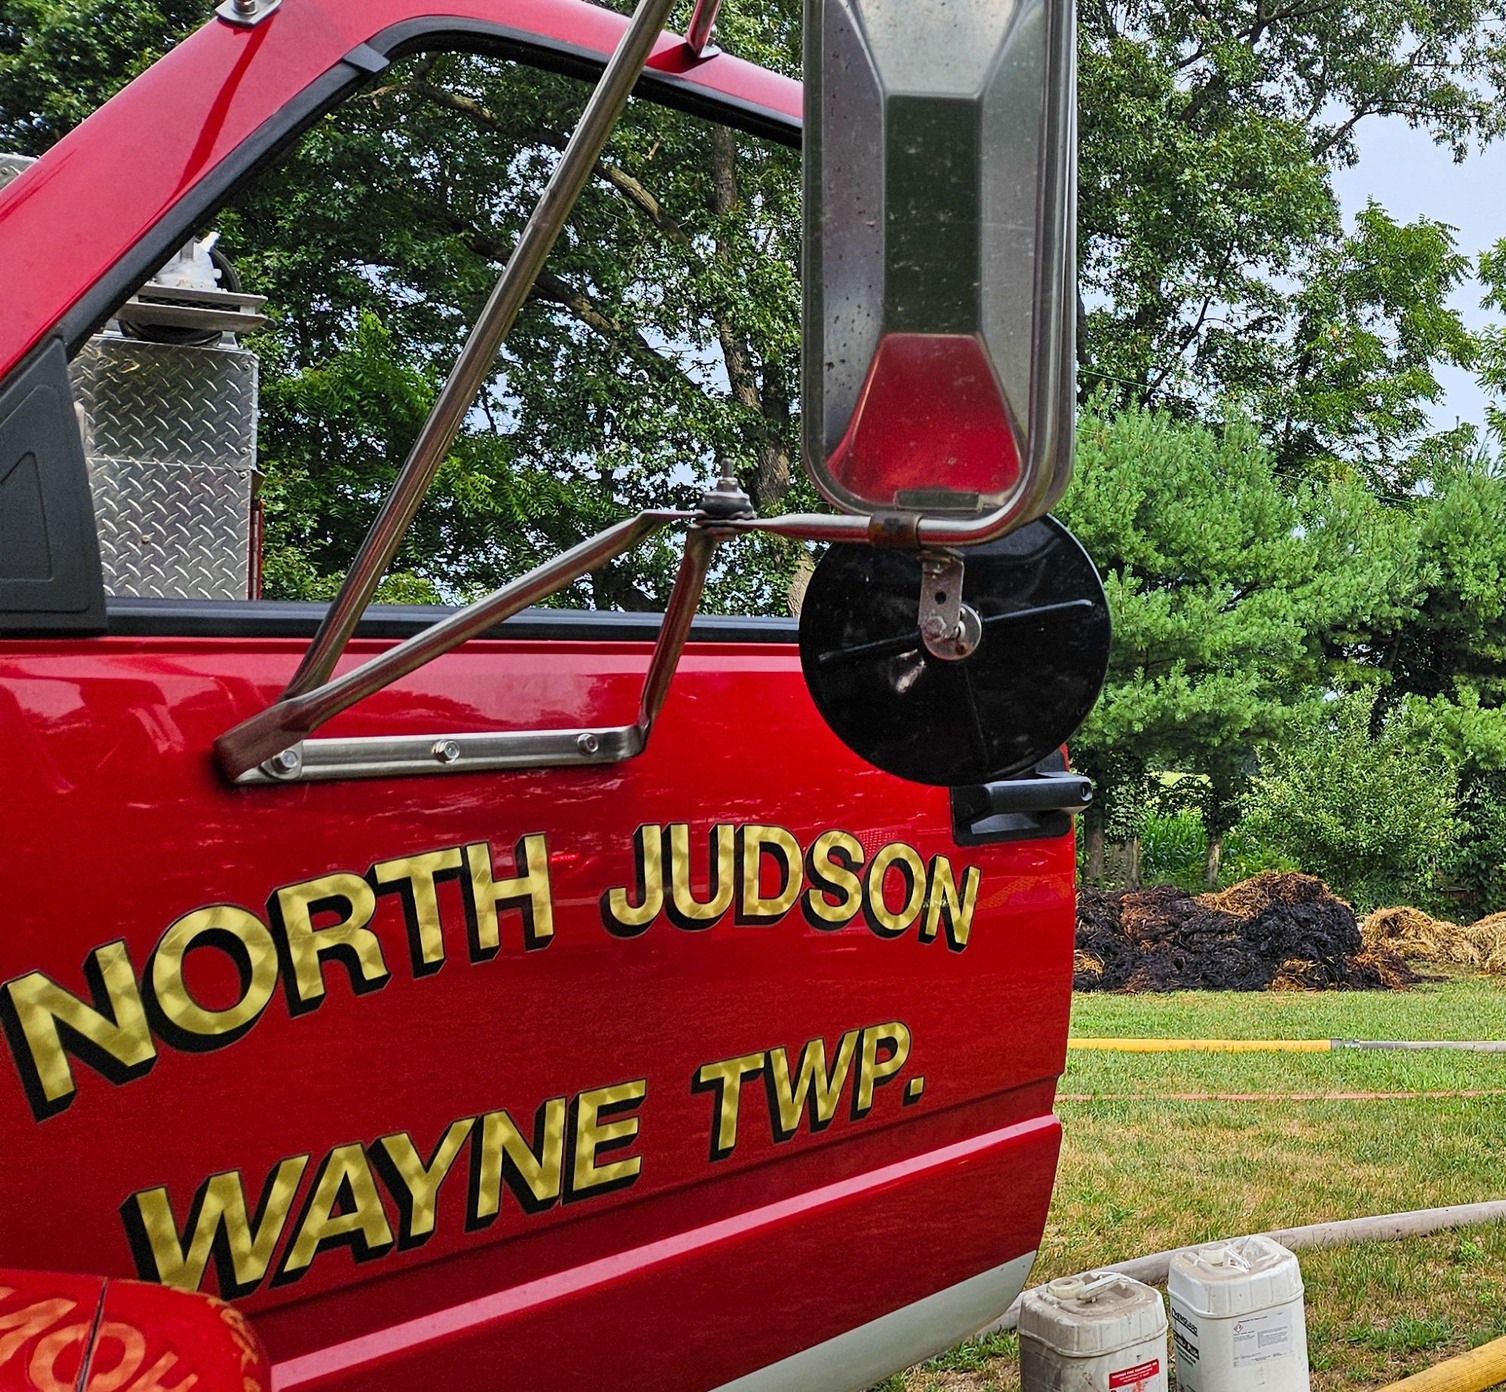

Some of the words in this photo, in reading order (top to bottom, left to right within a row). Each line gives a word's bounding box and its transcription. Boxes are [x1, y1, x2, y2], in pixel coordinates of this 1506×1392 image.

[2, 834, 552, 1122] NORTH
[602, 823, 981, 953] JUDSON
[119, 1077, 647, 1300] WAYNE
[691, 1019, 927, 1162] TWP.
